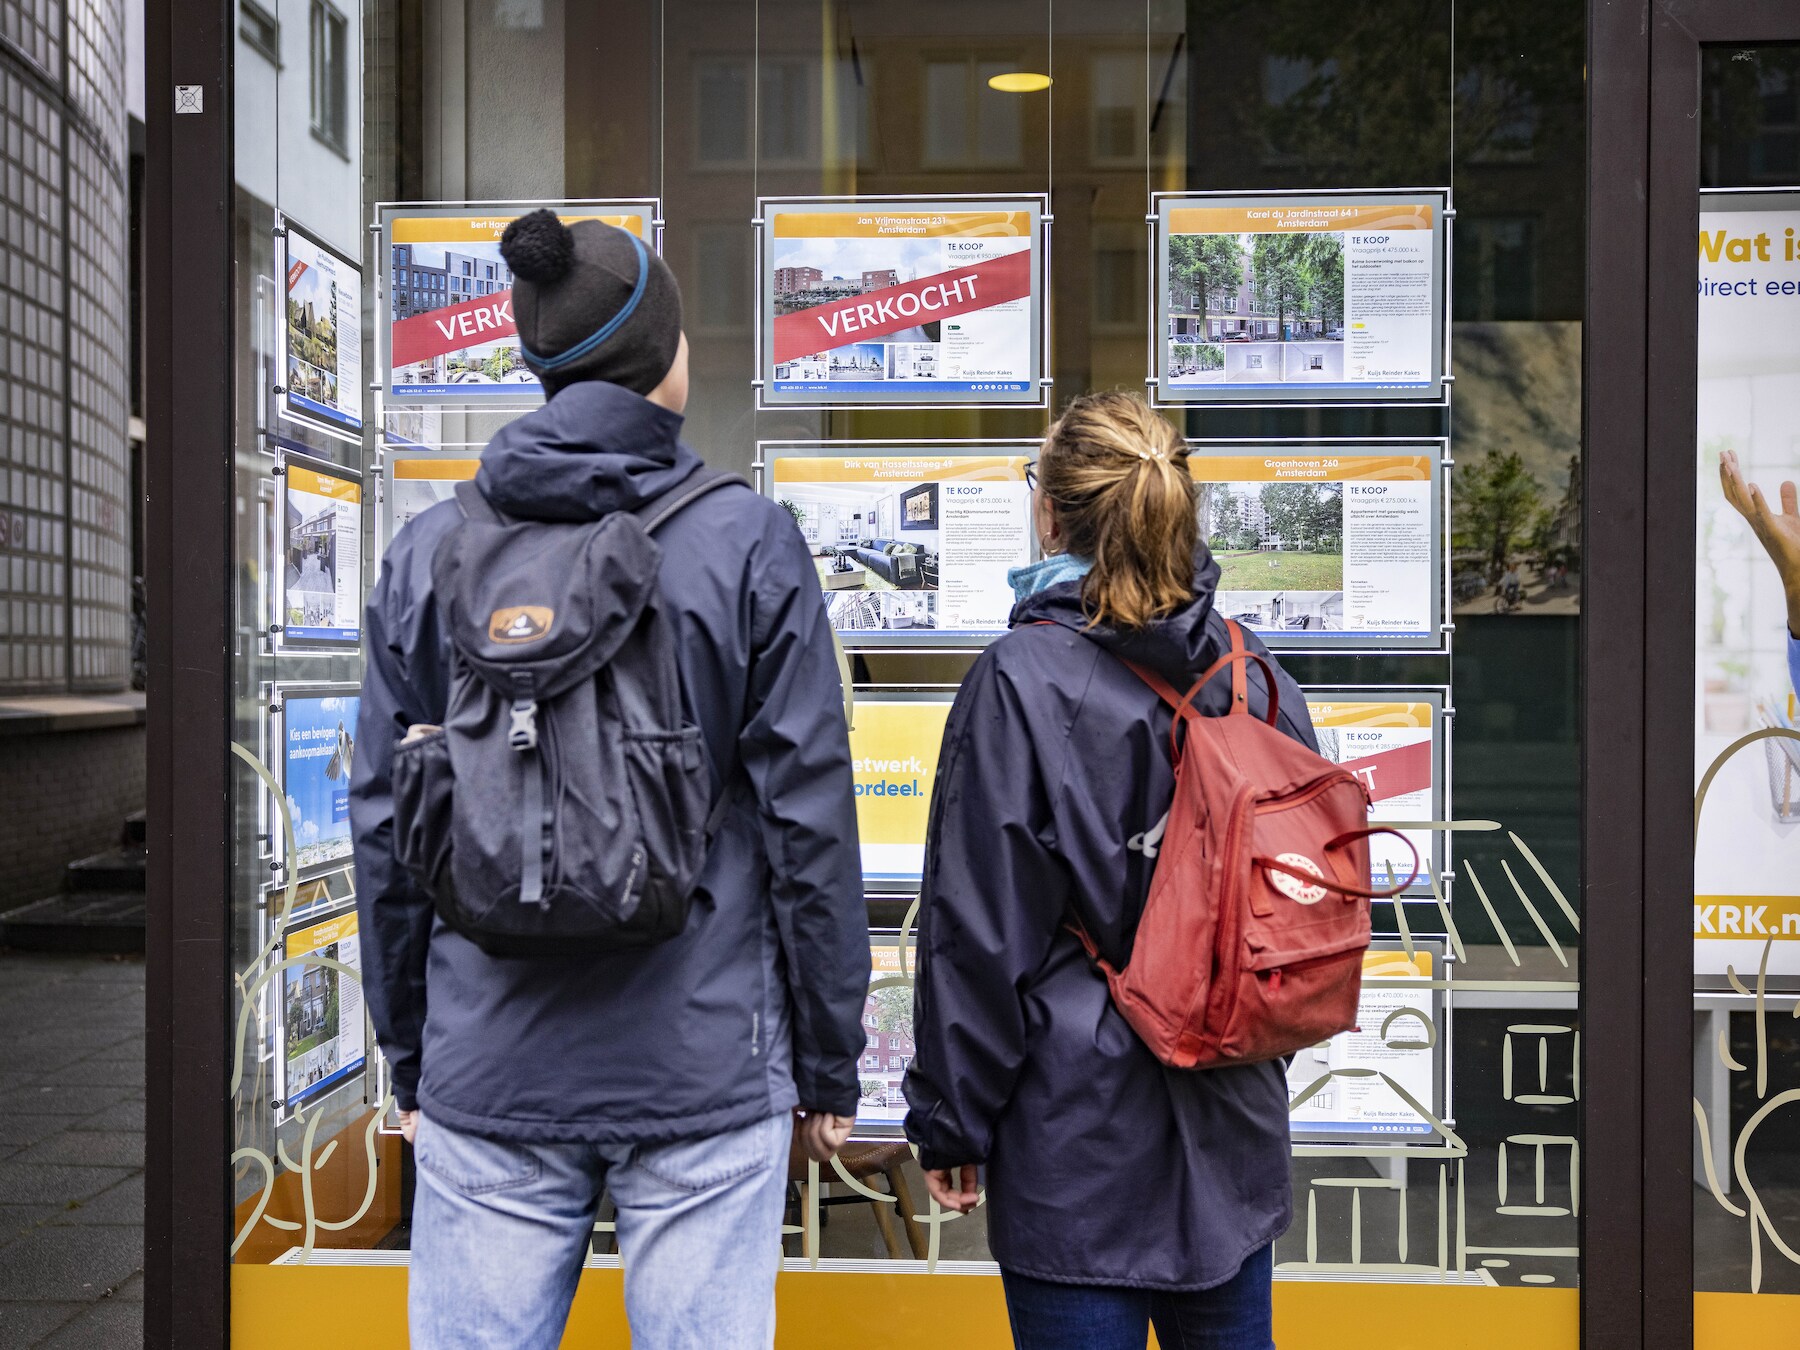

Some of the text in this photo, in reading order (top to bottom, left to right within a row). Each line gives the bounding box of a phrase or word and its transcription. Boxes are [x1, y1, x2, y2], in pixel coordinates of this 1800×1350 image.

[1247, 209, 1358, 219] Karel du Jardinstraat 64 1
[471, 221, 487, 229] Bert
[857, 216, 946, 226] Jan Vrijmanstraat 231
[1276, 220, 1329, 228] Amsterdam
[877, 226, 927, 234] Amsterdam
[1352, 236, 1390, 244] TE KOOP
[948, 243, 984, 251] TE KOOP
[1698, 227, 1800, 263] Wat i
[817, 274, 979, 337] VERKOCHT
[844, 460, 953, 470] Dirk van Hasseltssteeg 49
[1264, 459, 1339, 468] Groenhoven 260
[873, 470, 924, 478] Amsterdam
[1275, 469, 1328, 477] Amsterdam
[946, 487, 983, 495] TE KOOP
[1350, 486, 1388, 495] TE KOOP
[1322, 706, 1333, 714] 49
[289, 725, 336, 741] Kies een bevlogen
